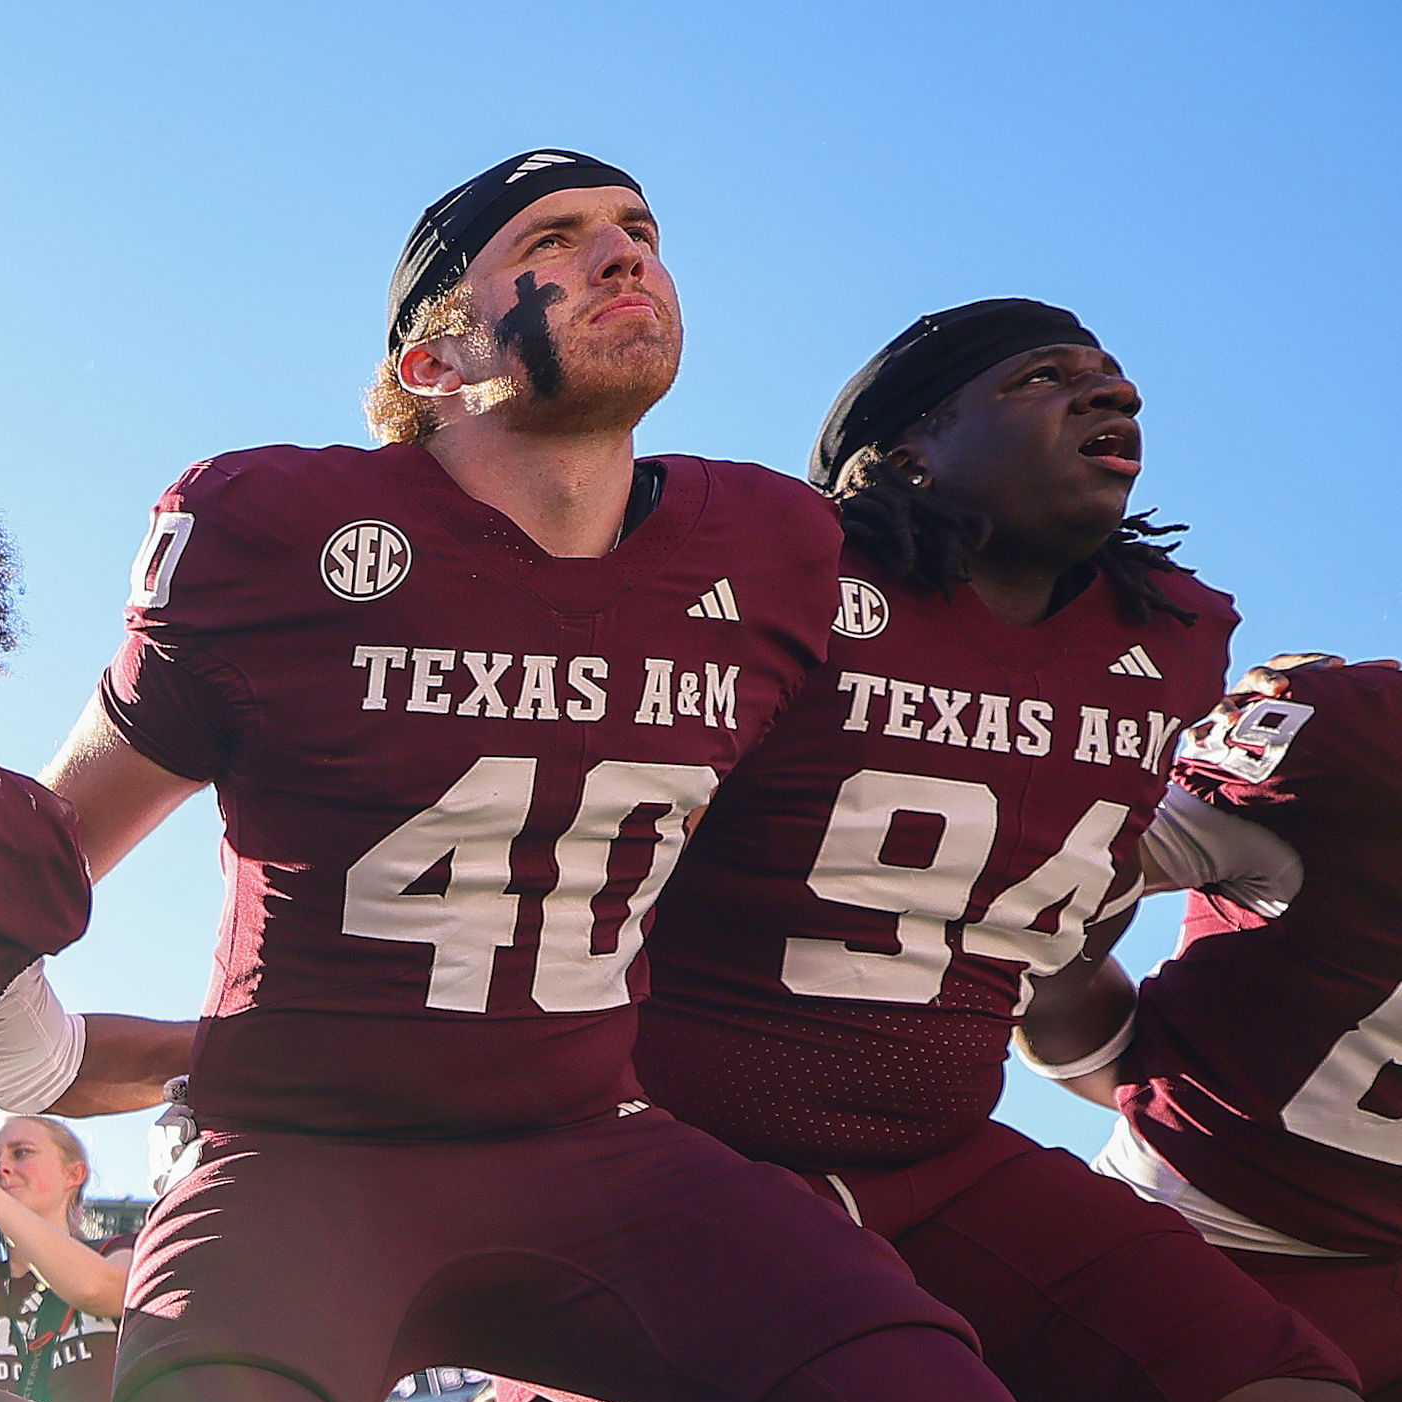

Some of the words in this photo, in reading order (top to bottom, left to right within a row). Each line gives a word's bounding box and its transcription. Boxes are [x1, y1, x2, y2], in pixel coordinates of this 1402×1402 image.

[326, 525, 406, 596] SEC
[836, 581, 885, 635] EC
[352, 645, 609, 722] TEXAS
[634, 656, 741, 729] A&M
[837, 671, 1053, 758] TEXAS
[341, 755, 720, 1014] 40
[780, 767, 1130, 1018] 94
